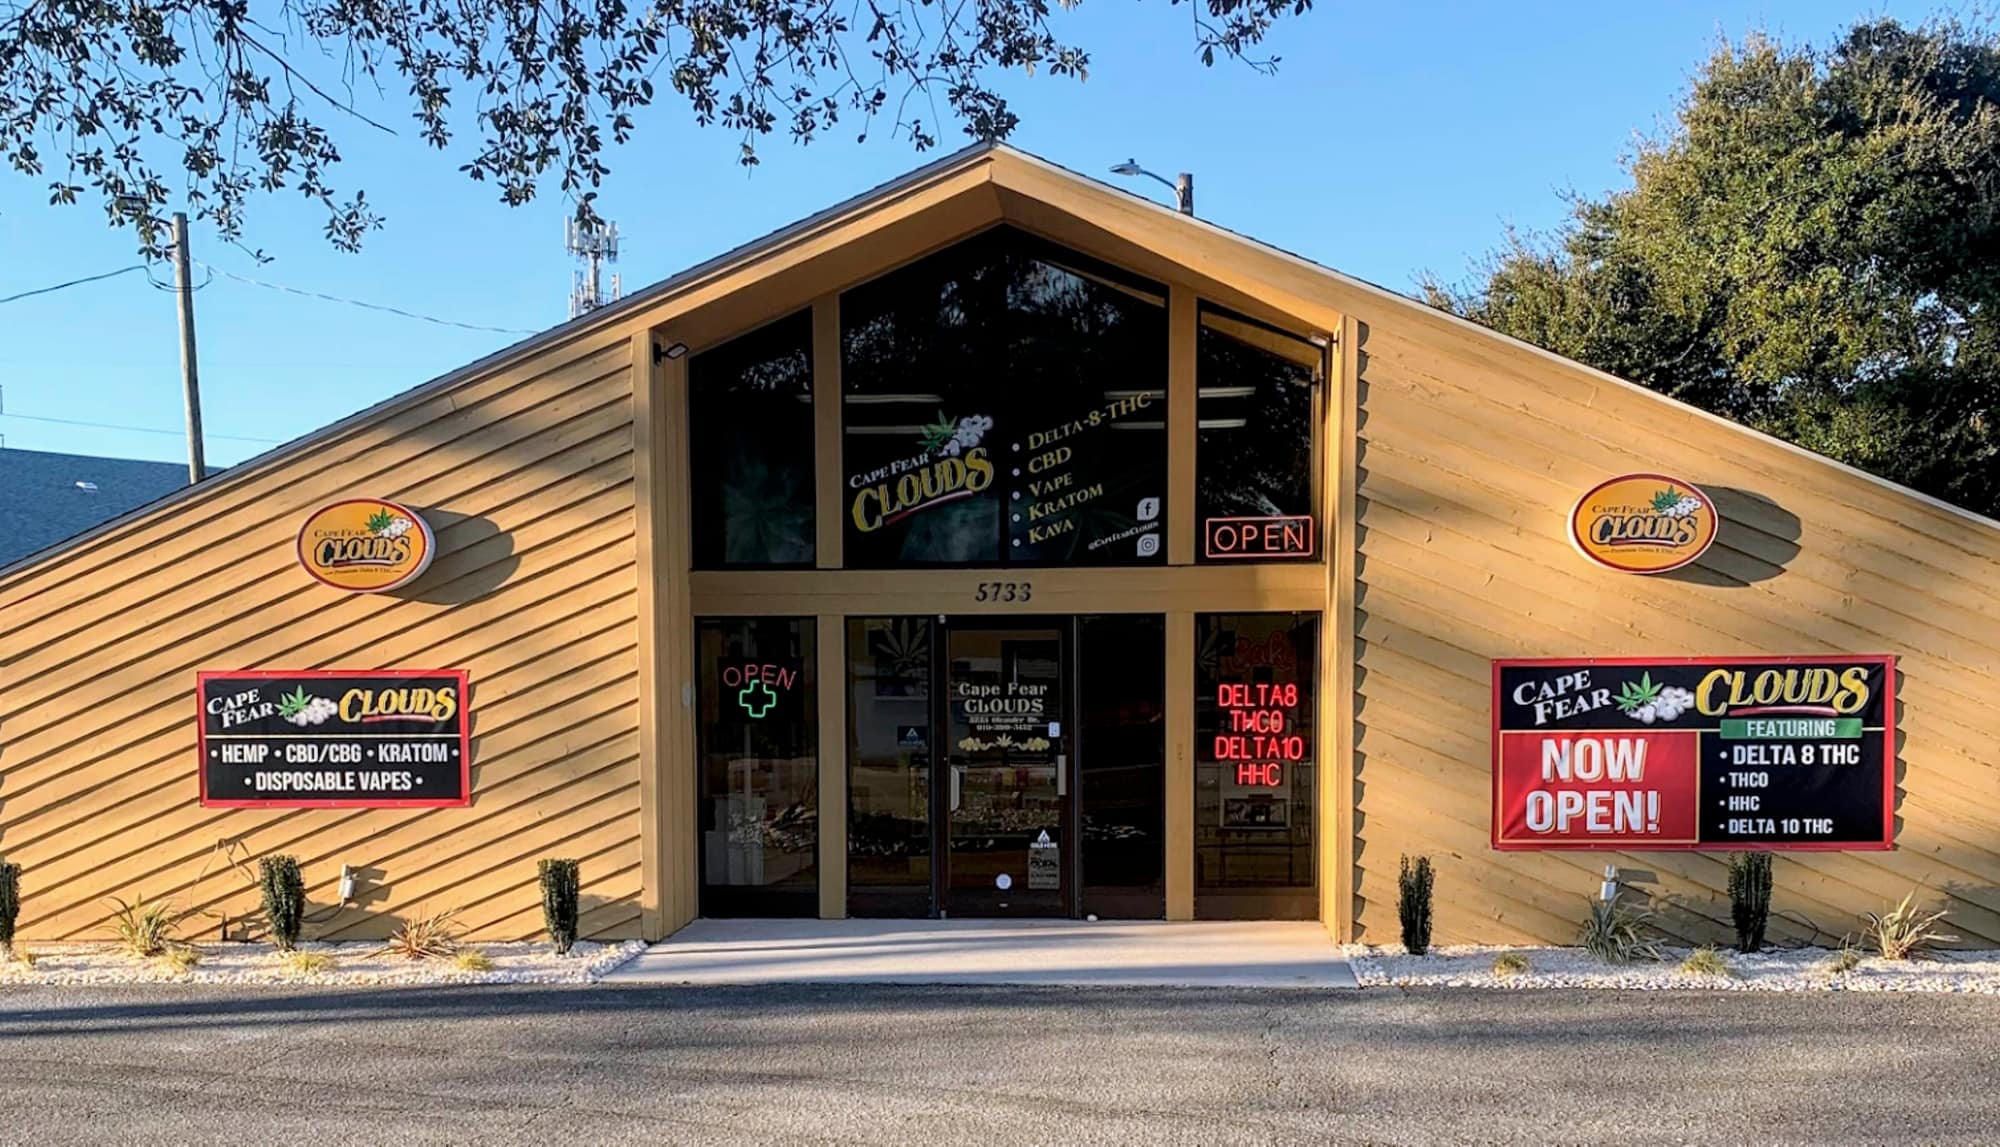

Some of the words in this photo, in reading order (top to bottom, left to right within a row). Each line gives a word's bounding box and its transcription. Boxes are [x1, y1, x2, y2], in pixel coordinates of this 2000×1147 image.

[850, 466, 888, 488] CAPE
[890, 453, 929, 475] FEAR
[1028, 447, 1072, 474] CBD
[852, 447, 994, 532] CLOUDS
[1029, 473, 1073, 497] VAPE
[1028, 483, 1103, 521] KRATOM
[1592, 504, 1621, 513] CAPE
[1622, 505, 1650, 514] FEAR
[314, 529, 338, 537] CAPE
[1028, 519, 1074, 544] KAVA
[1214, 524, 1304, 551] OPEN
[1590, 514, 1697, 545] CLOUDS
[314, 536, 411, 567] CLOUDS
[975, 583, 1032, 601] 5733
[723, 664, 797, 690] OPEN
[1513, 670, 1591, 706] CAPE
[207, 689, 260, 715] CAPE
[959, 683, 1001, 698] Cape
[1008, 682, 1048, 696] Fear
[1218, 684, 1298, 707] DELTA8
[1696, 667, 1869, 716] CLOUDS
[221, 702, 276, 729] FEAR
[339, 687, 457, 723] CLOUDS
[964, 698, 1044, 713] CLOUDS
[1534, 688, 1612, 726] FEAR
[1747, 720, 1836, 737] FEATURING
[222, 744, 268, 764] HEMP
[286, 744, 362, 764] CBD/CBG
[378, 743, 448, 763] KRATOM
[1214, 736, 1303, 760] DELTA10
[1542, 738, 1647, 783] NOW
[1733, 745, 1796, 765] DELTA
[1801, 744, 1814, 765] 8
[1820, 744, 1860, 765] THC
[256, 772, 354, 791] DISPOSABLE
[359, 772, 412, 791] VAPES
[1238, 763, 1280, 786] HHC
[1729, 772, 1769, 788] THCO
[1526, 790, 1661, 834] OPEN!
[1728, 796, 1760, 811] HHC
[1728, 819, 1776, 834] DELTA
[1781, 819, 1800, 834] 10
[1803, 818, 1833, 834] THC
